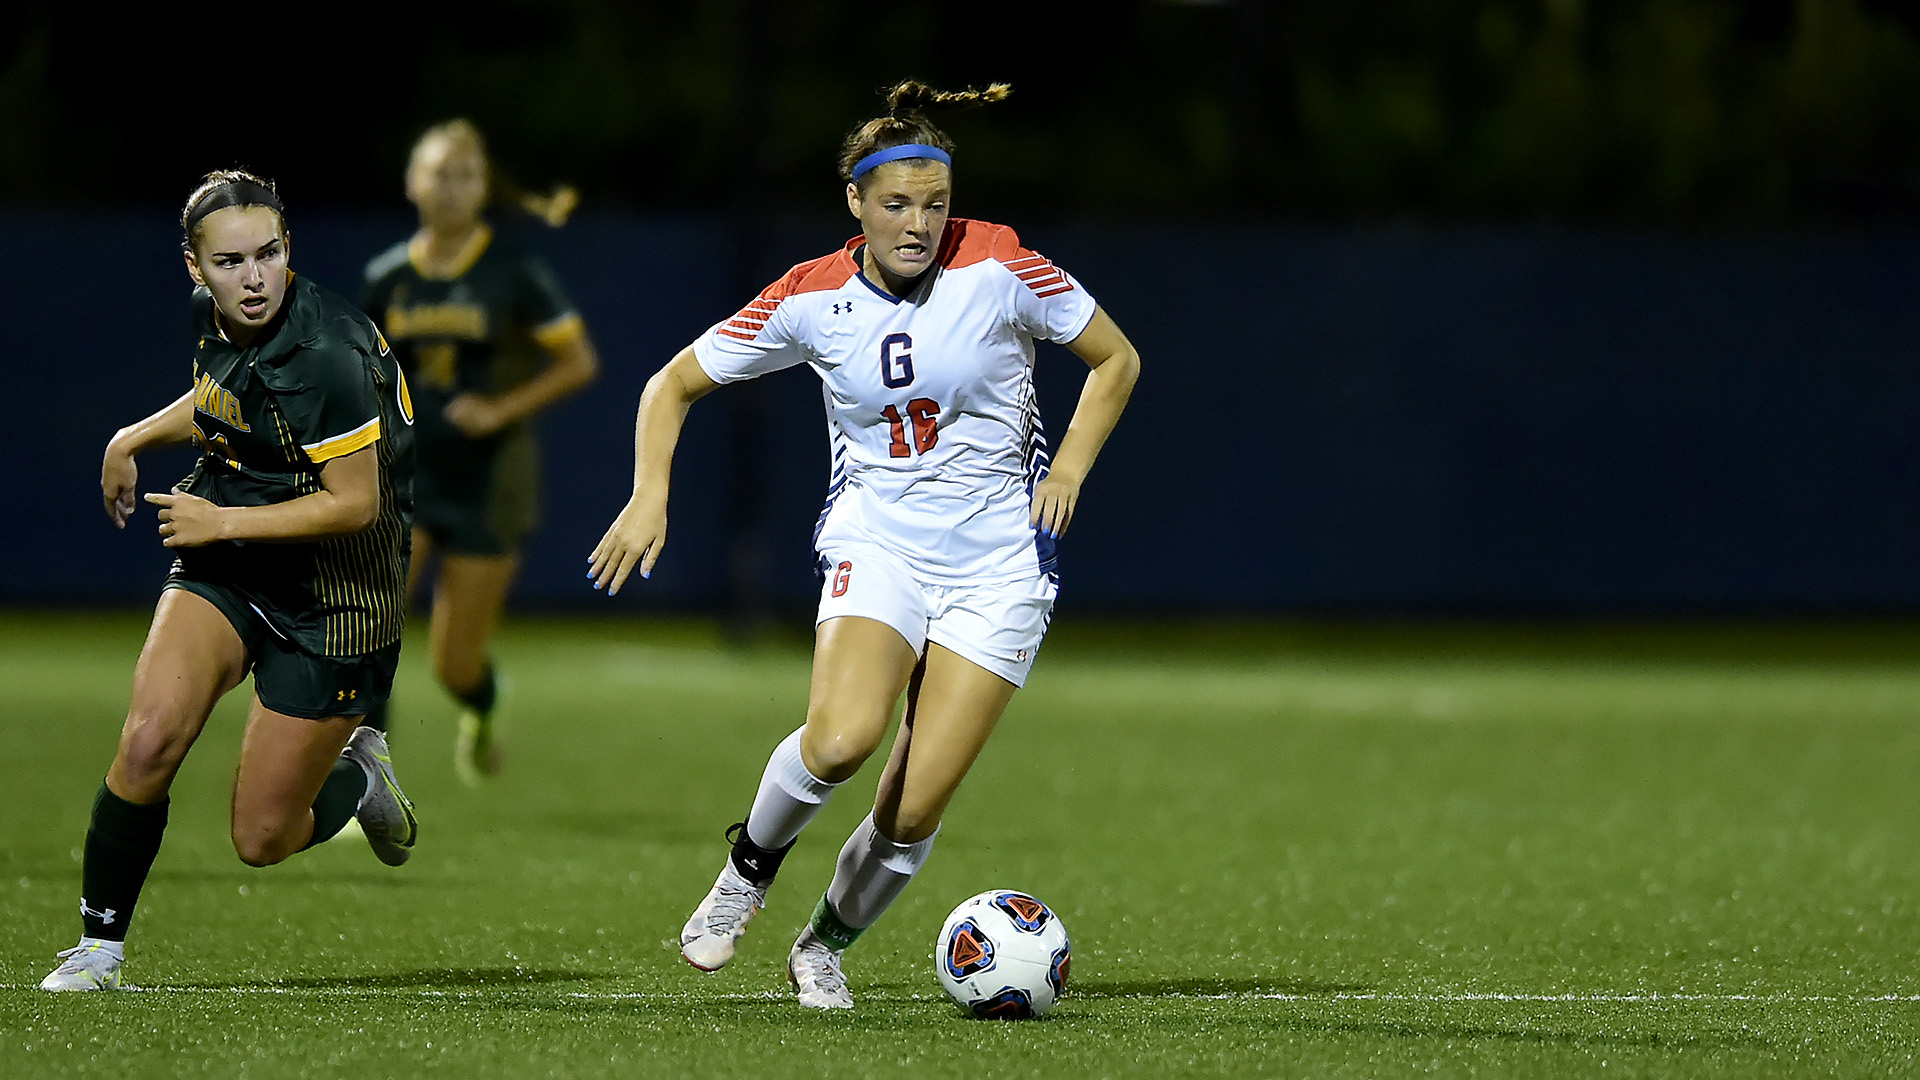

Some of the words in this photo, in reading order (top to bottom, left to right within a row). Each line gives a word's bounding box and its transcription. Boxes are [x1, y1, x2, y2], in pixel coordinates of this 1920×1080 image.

[881, 332, 915, 389] G
[880, 397, 941, 458] 16
[832, 560, 852, 598] G
